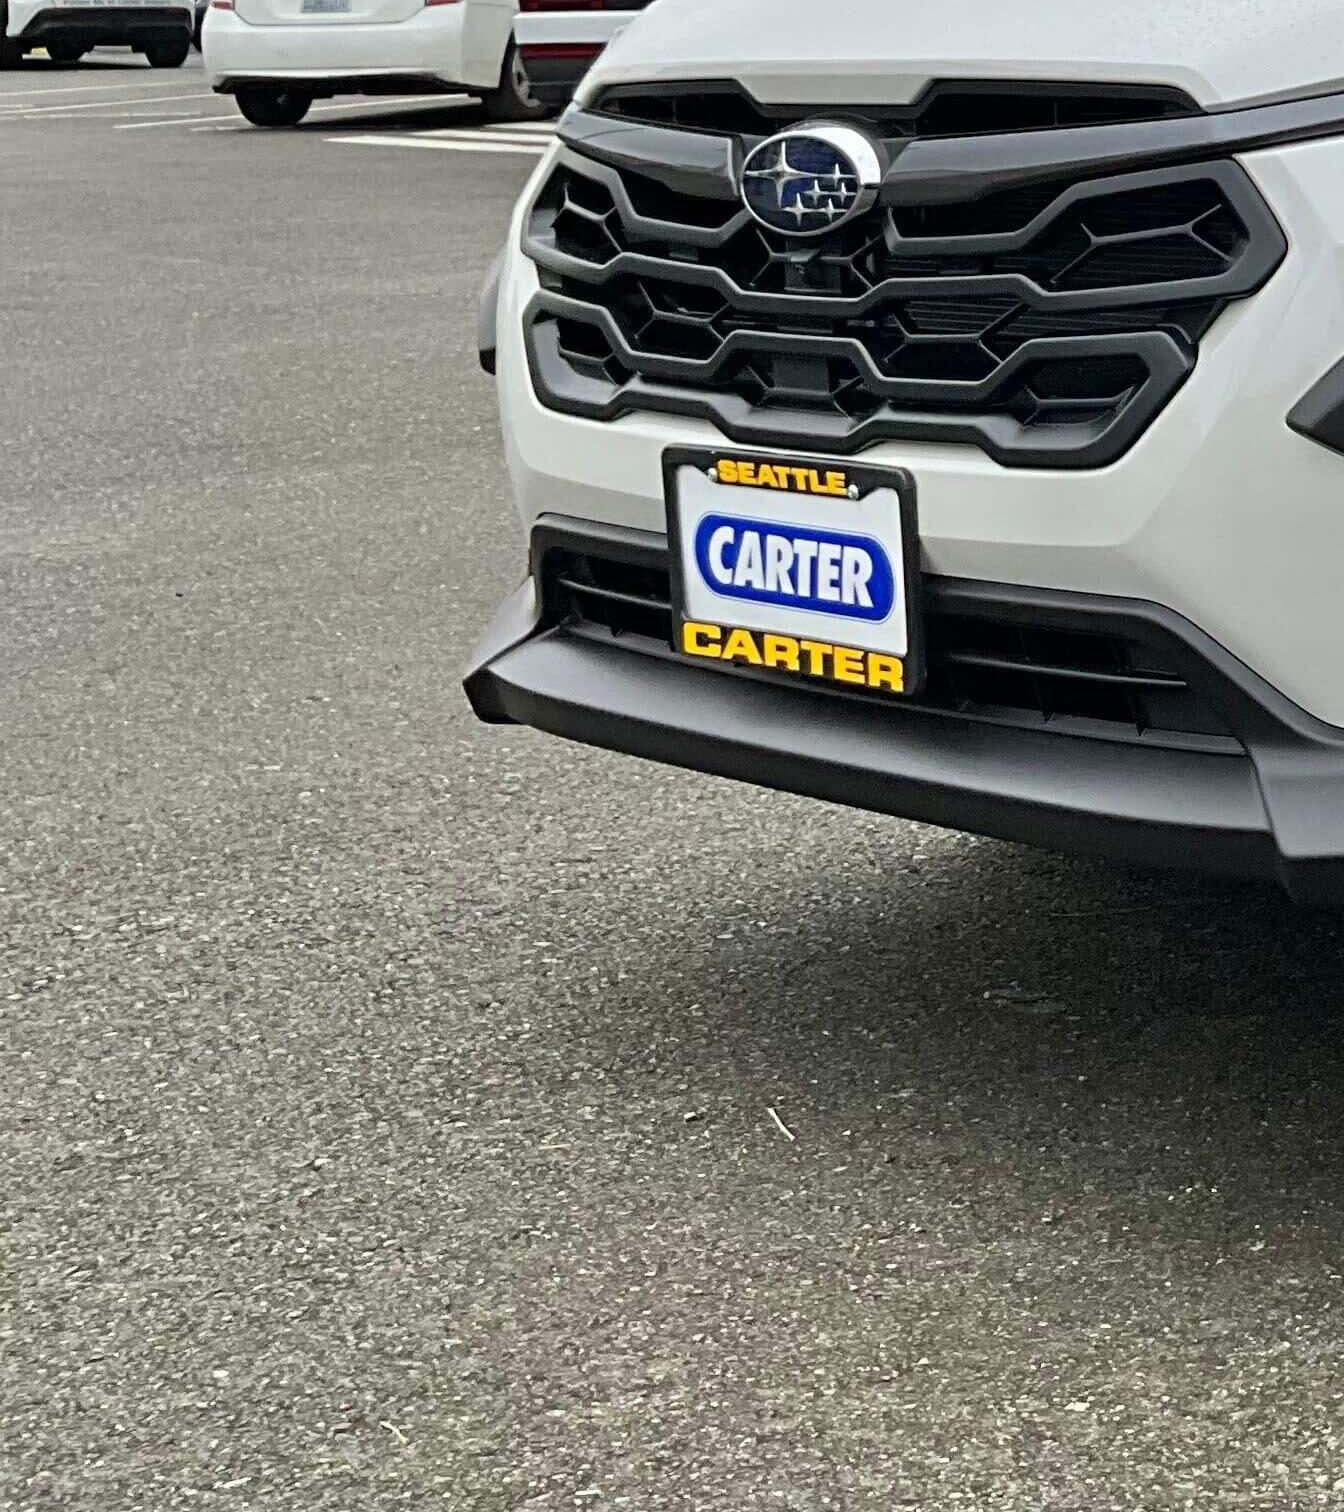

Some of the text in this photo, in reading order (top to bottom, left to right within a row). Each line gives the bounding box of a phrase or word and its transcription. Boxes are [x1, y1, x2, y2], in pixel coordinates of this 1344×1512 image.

[716, 458, 848, 496] SEATTLE
[708, 527, 876, 609] CARTER
[682, 620, 905, 694] CARTER
